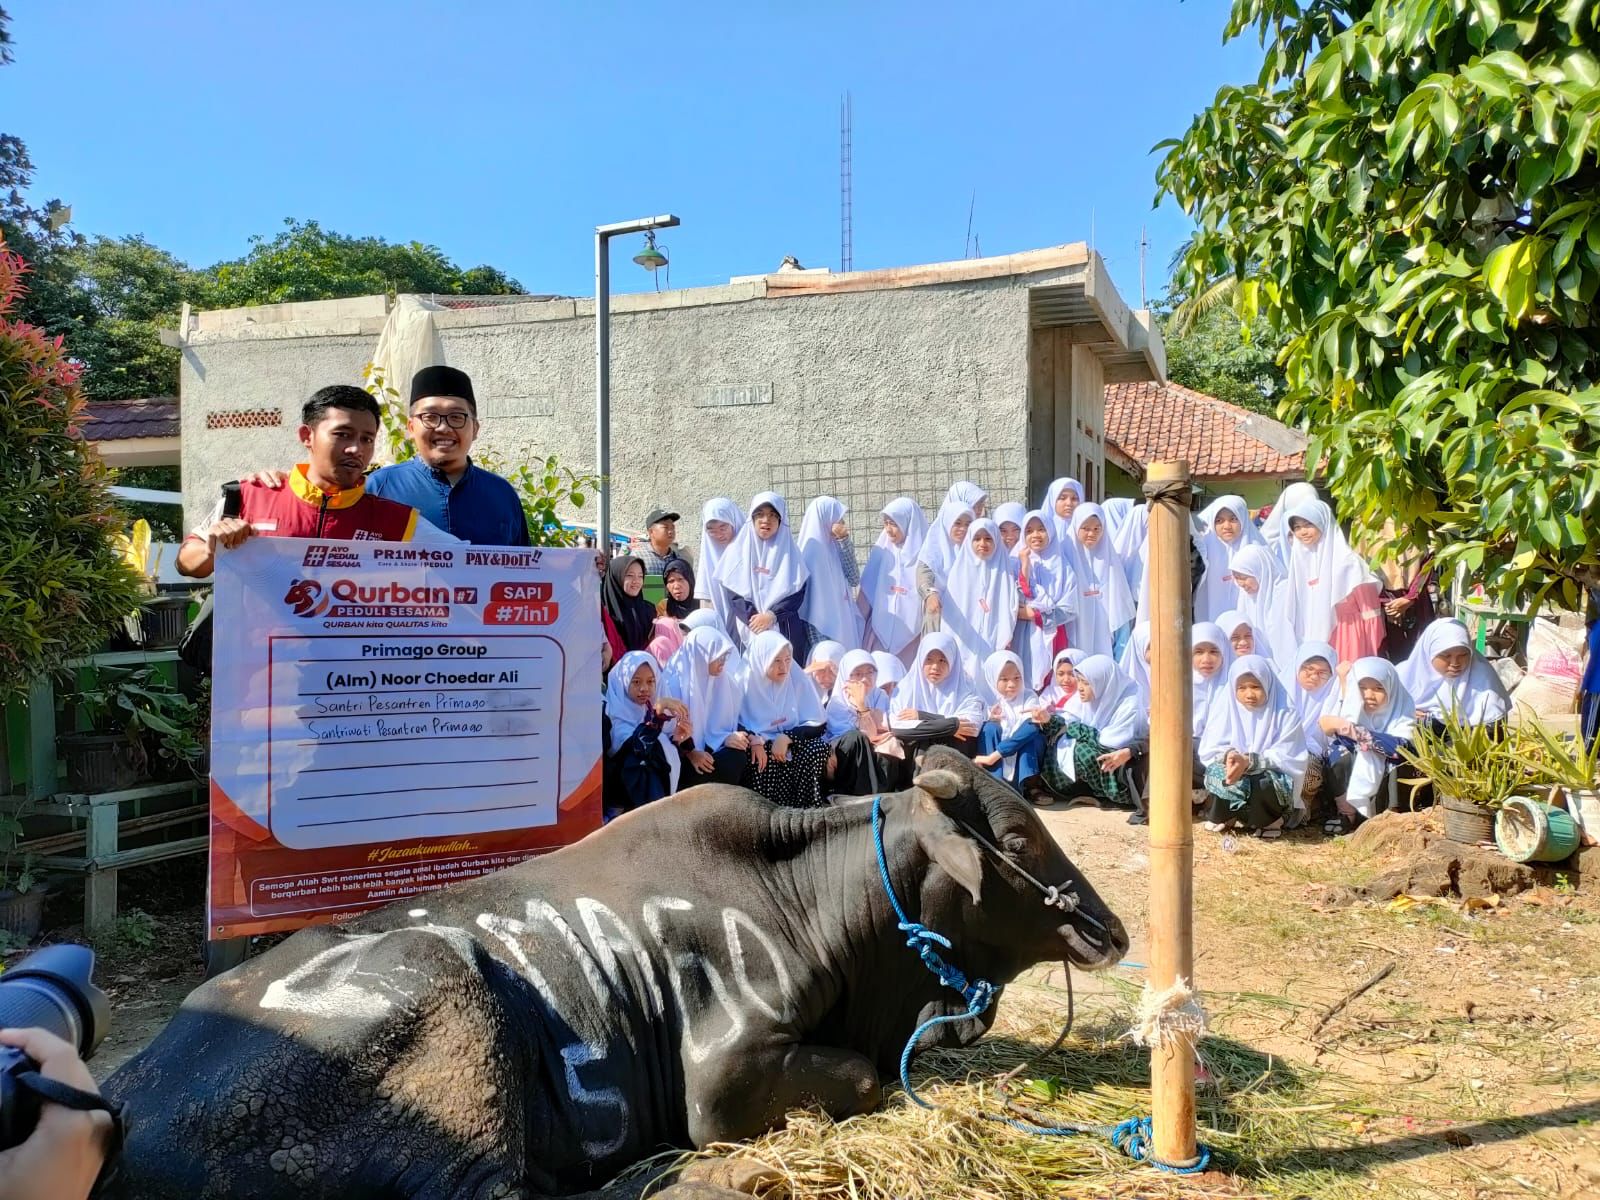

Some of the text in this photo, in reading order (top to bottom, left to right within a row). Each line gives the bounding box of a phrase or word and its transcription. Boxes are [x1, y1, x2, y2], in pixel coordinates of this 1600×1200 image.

[326, 560, 361, 568] SESAMA
[424, 561, 453, 569] PEDULI
[331, 579, 476, 604] Qurban #7
[503, 586, 541, 600] SAPI
[337, 607, 445, 616] PEDULI SESAMA
[496, 605, 549, 622] #7in1
[323, 621, 364, 629] QURBAN
[385, 621, 429, 629] QUALITAS
[431, 620, 448, 628] kita
[362, 643, 488, 660] Primago Group
[326, 670, 519, 690] (Alm) Noor Choedar Ali
[314, 693, 486, 713] Santri Pesantren Primago
[308, 717, 483, 739] Santriwati Pesantren Primago
[258, 882, 295, 892] Semoga
[297, 878, 319, 887] Allah
[321, 876, 338, 884] Swt
[340, 872, 382, 882] menerima
[384, 868, 411, 878] segala
[461, 859, 490, 869] Qurban
[507, 855, 521, 863] dan
[319, 885, 341, 894] lebih
[363, 880, 384, 889] lebih
[386, 876, 415, 888] banyak
[437, 869, 481, 880] berkualitas
